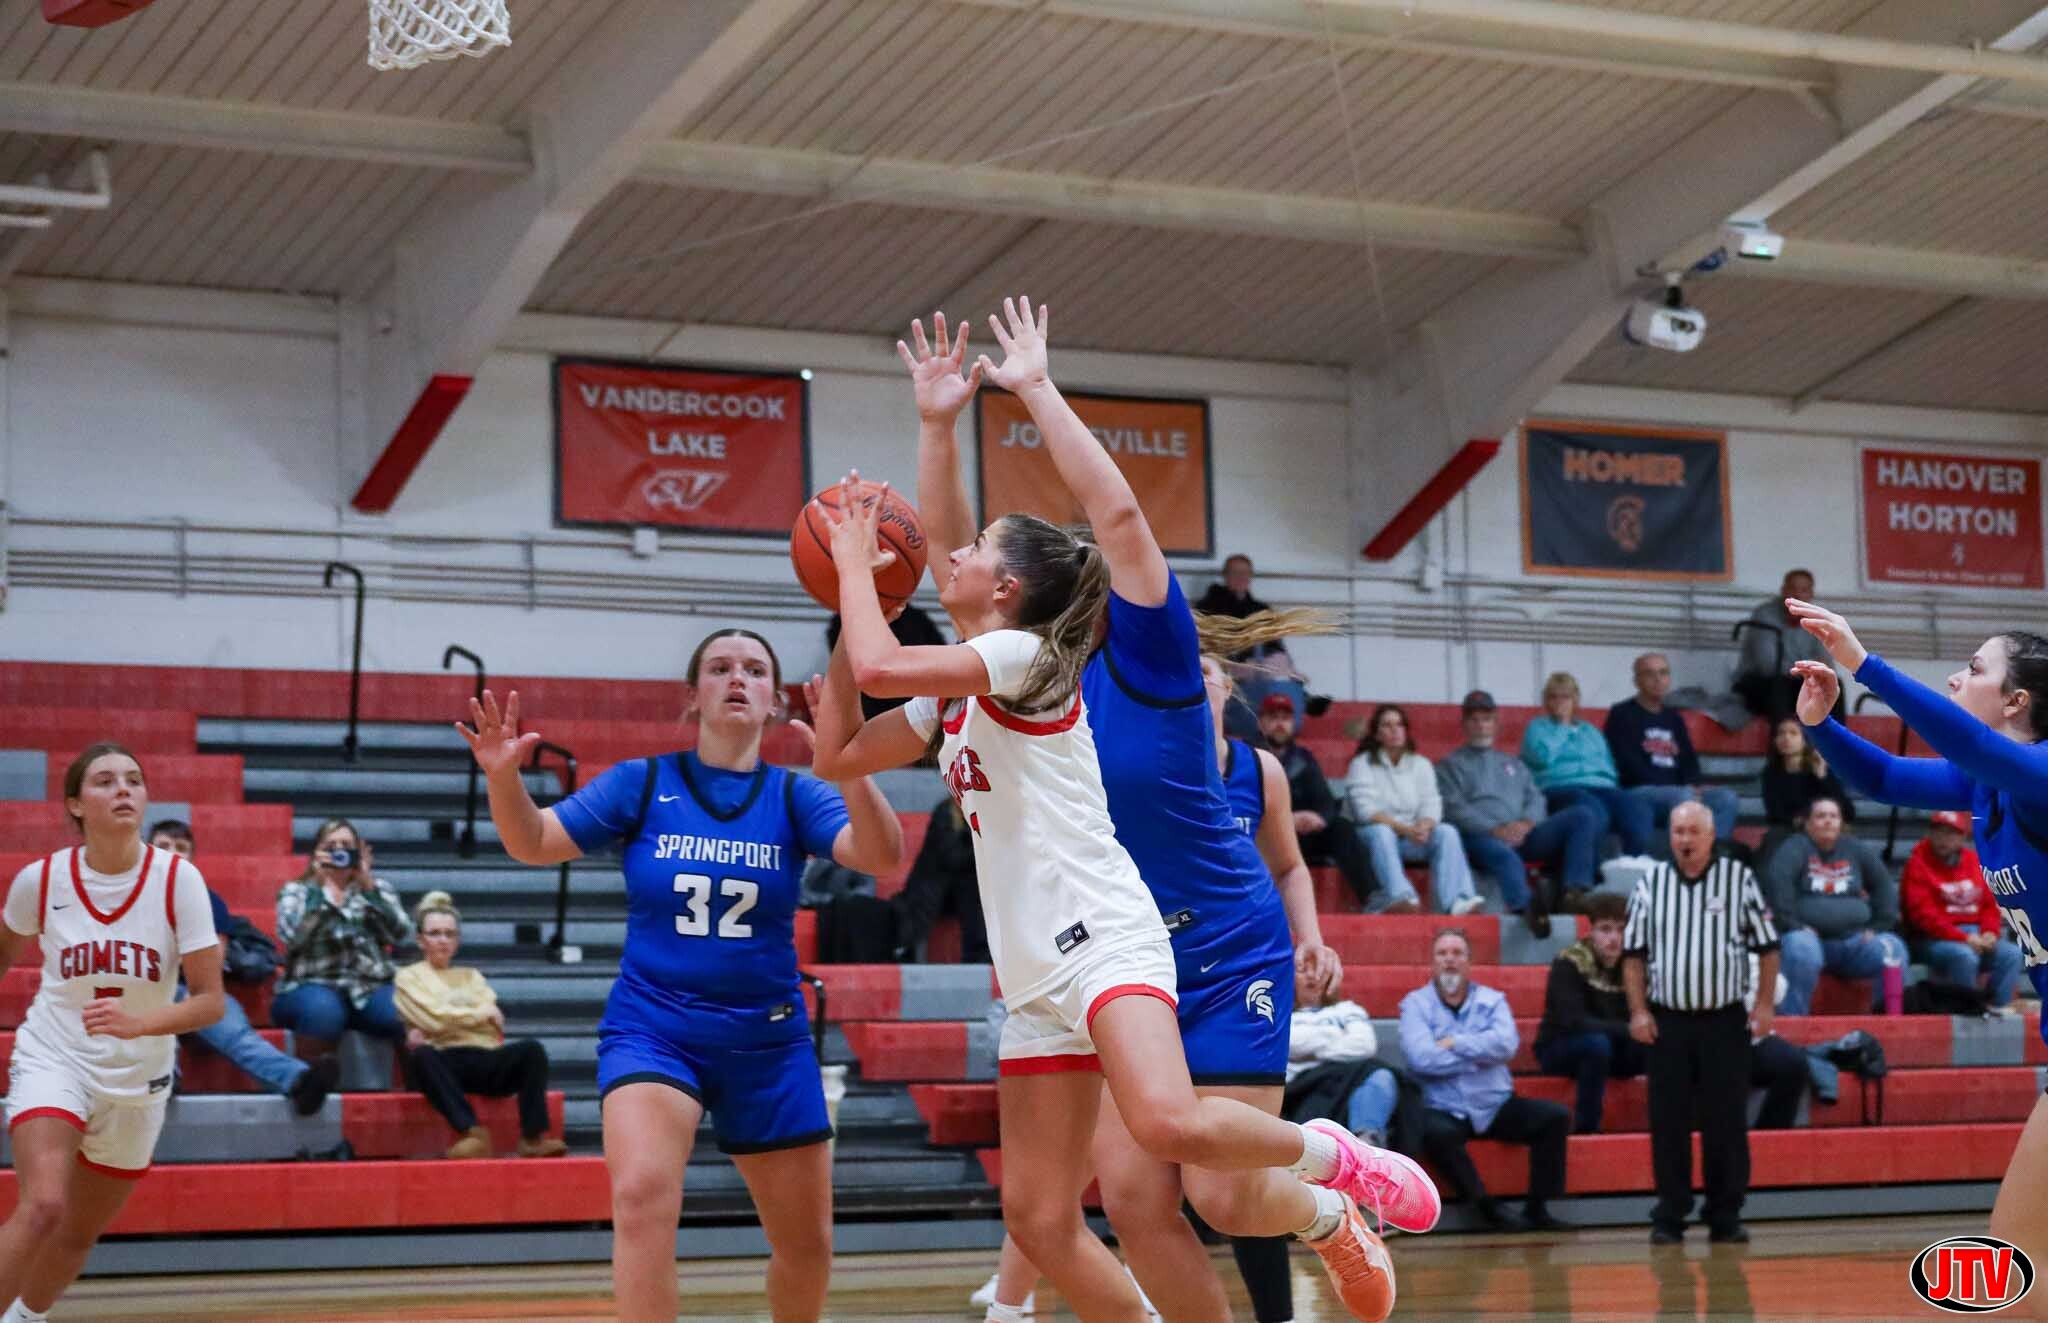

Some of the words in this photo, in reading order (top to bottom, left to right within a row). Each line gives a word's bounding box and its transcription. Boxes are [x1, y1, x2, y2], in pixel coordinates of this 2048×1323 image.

[579, 383, 786, 420] VANDERCOOK
[648, 430, 727, 460] LAKE
[1001, 421, 1188, 459] JOVILLE
[1563, 448, 1686, 488] HOMER
[1876, 457, 2027, 494] HANOVER
[1888, 501, 2018, 537] HORTON
[655, 833, 783, 871] SPRINGPORT
[673, 873, 760, 938] 32
[60, 939, 161, 983] COMETS
